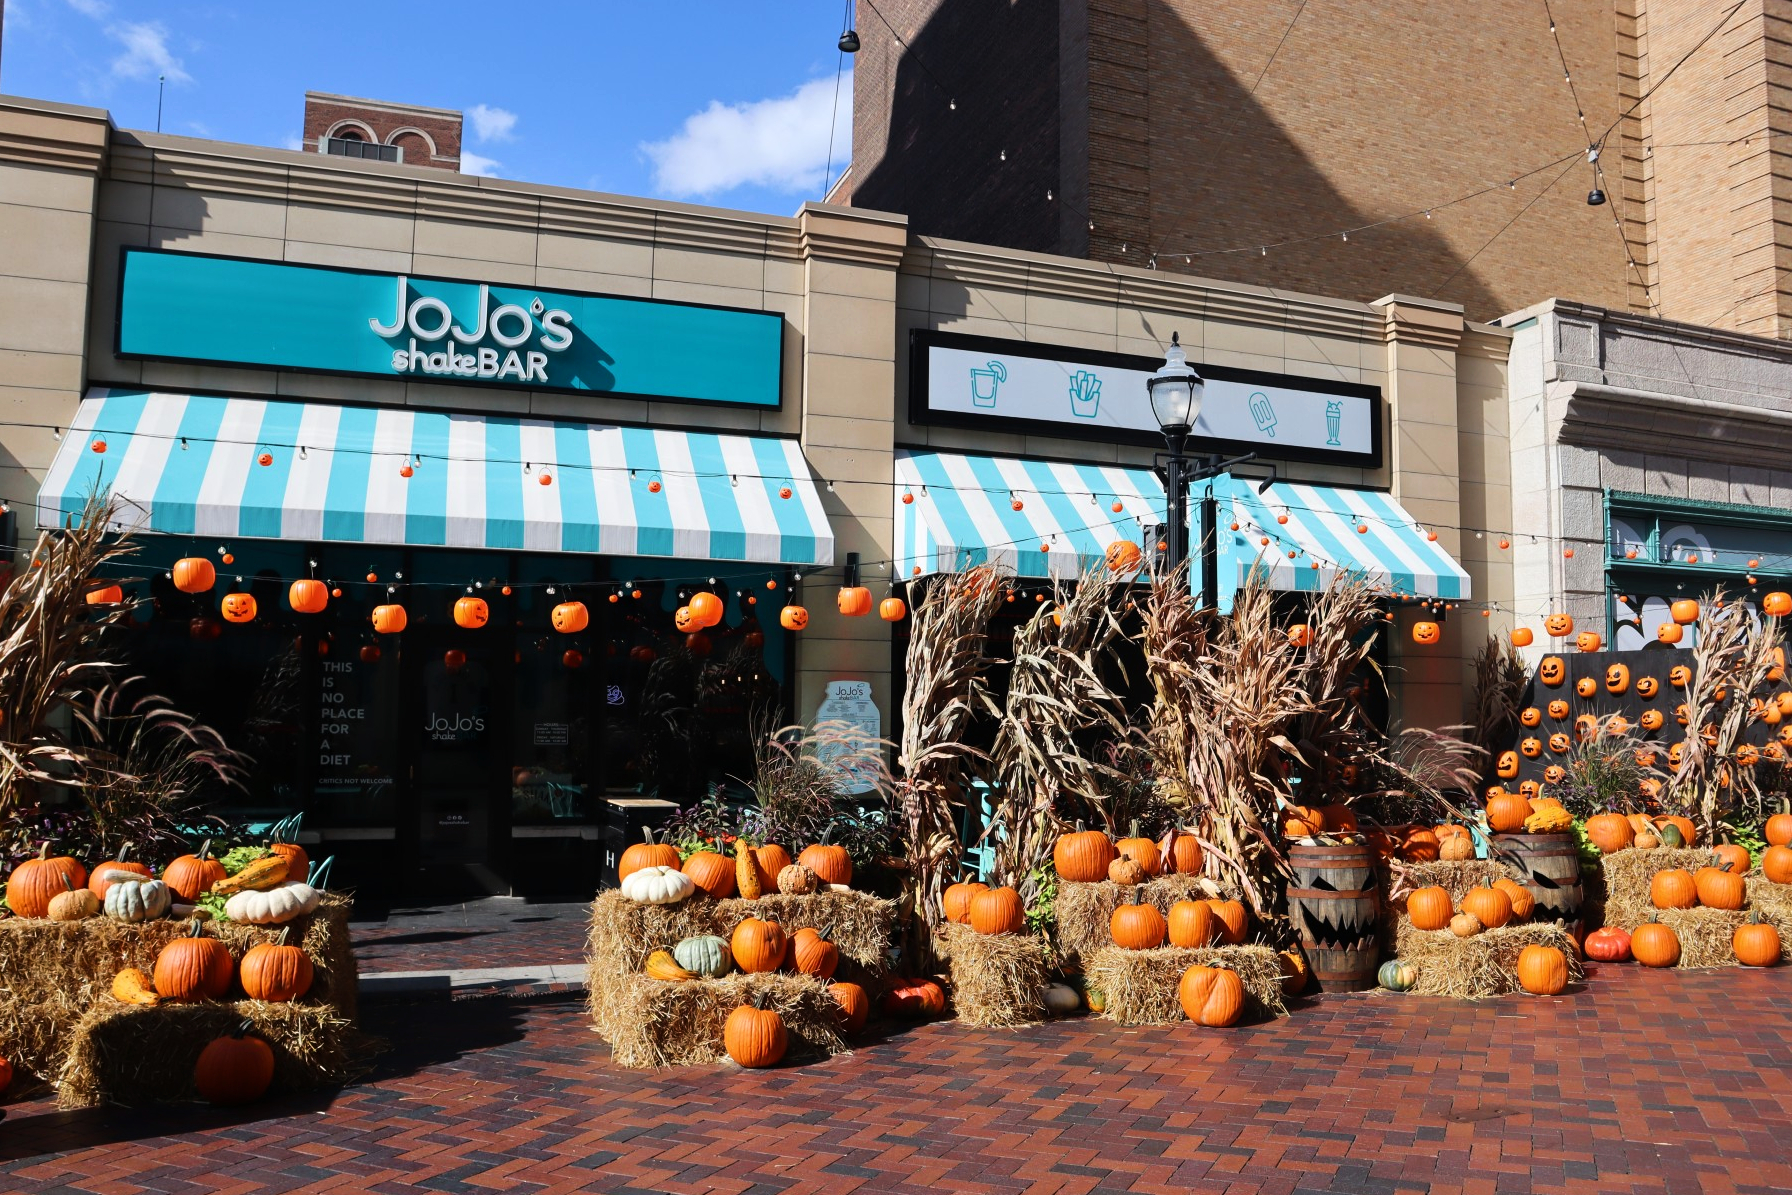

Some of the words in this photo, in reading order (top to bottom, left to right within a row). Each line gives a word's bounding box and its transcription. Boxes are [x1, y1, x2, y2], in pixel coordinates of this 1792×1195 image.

[368, 275, 573, 352] JoJo's
[391, 338, 548, 382] shakeBAR
[322, 661, 353, 673] THIS
[322, 677, 334, 688] IS
[836, 686, 863, 696] JoJo's
[322, 692, 344, 703] NO
[321, 708, 365, 719] PLACE
[424, 712, 485, 731] JoJo's
[321, 723, 349, 734] FOR
[320, 739, 330, 750] A
[320, 754, 351, 766] DIET
